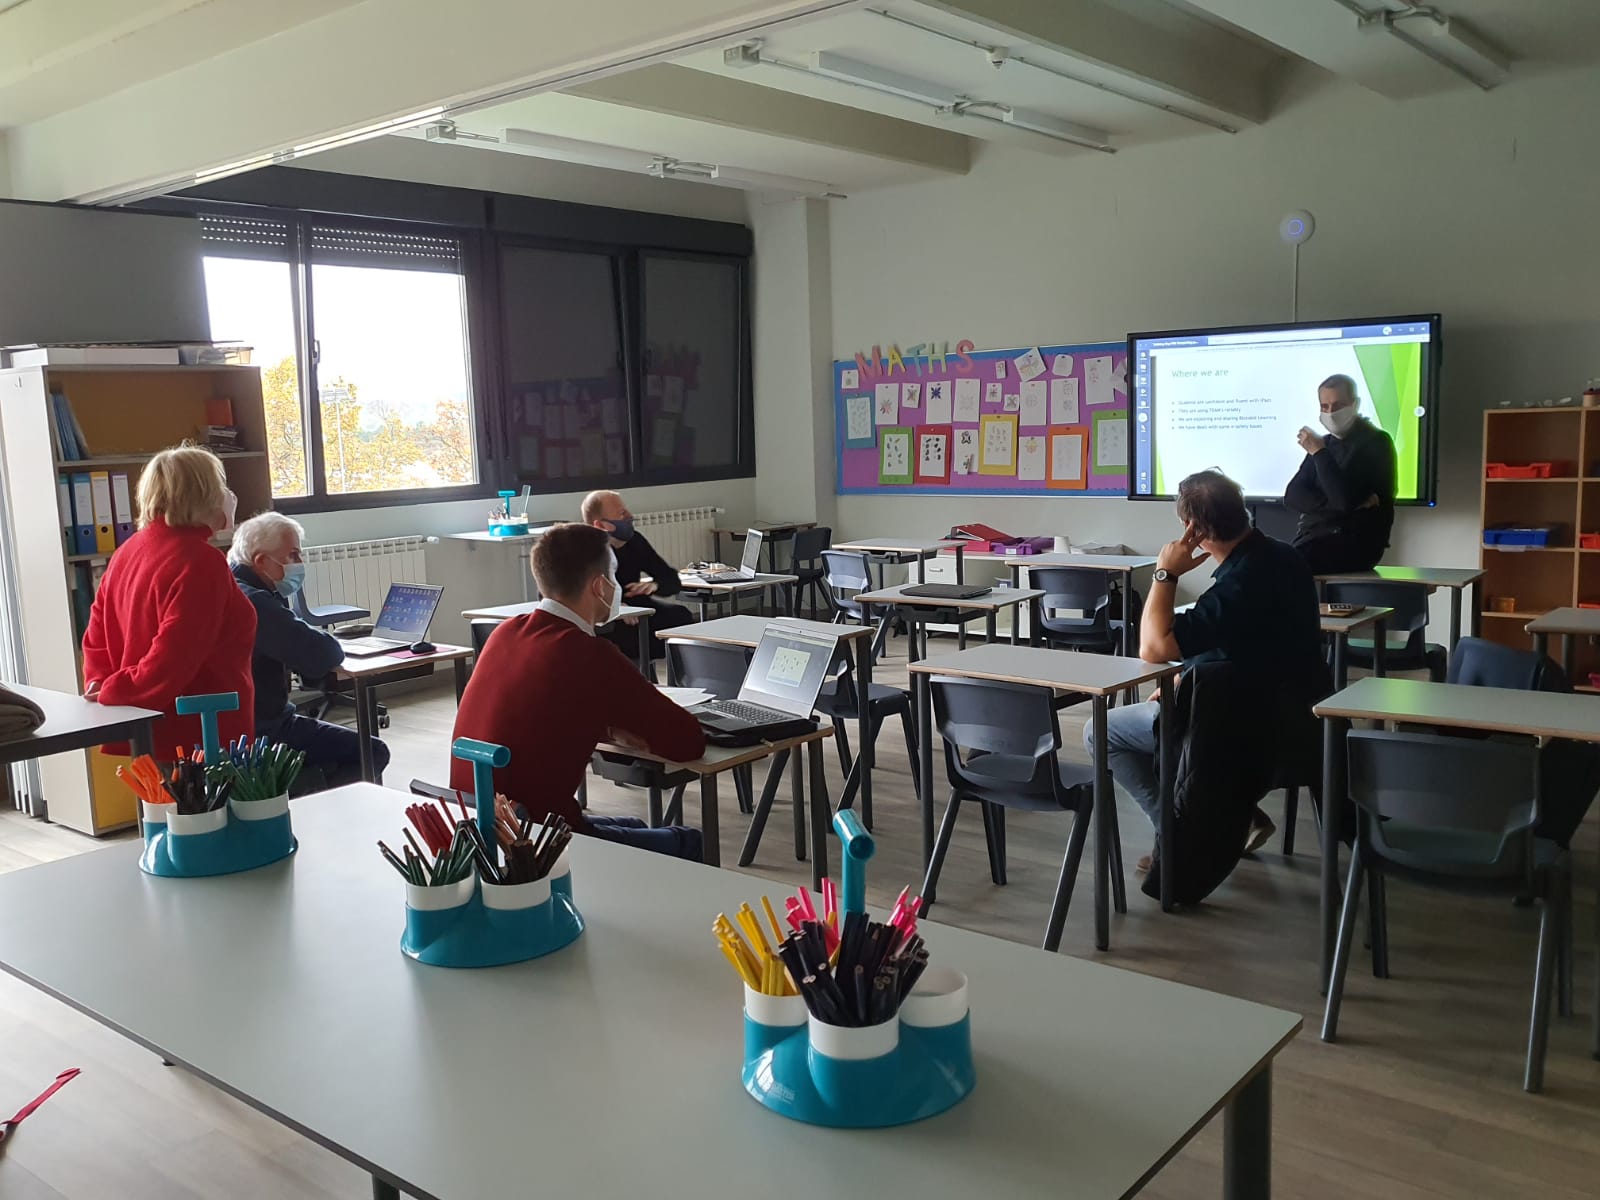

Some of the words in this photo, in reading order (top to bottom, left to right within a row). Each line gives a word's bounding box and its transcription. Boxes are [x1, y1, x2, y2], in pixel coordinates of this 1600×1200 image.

[855, 339, 975, 380] MATHS
[1171, 369, 1198, 378] Where
[1214, 369, 1229, 377] are
